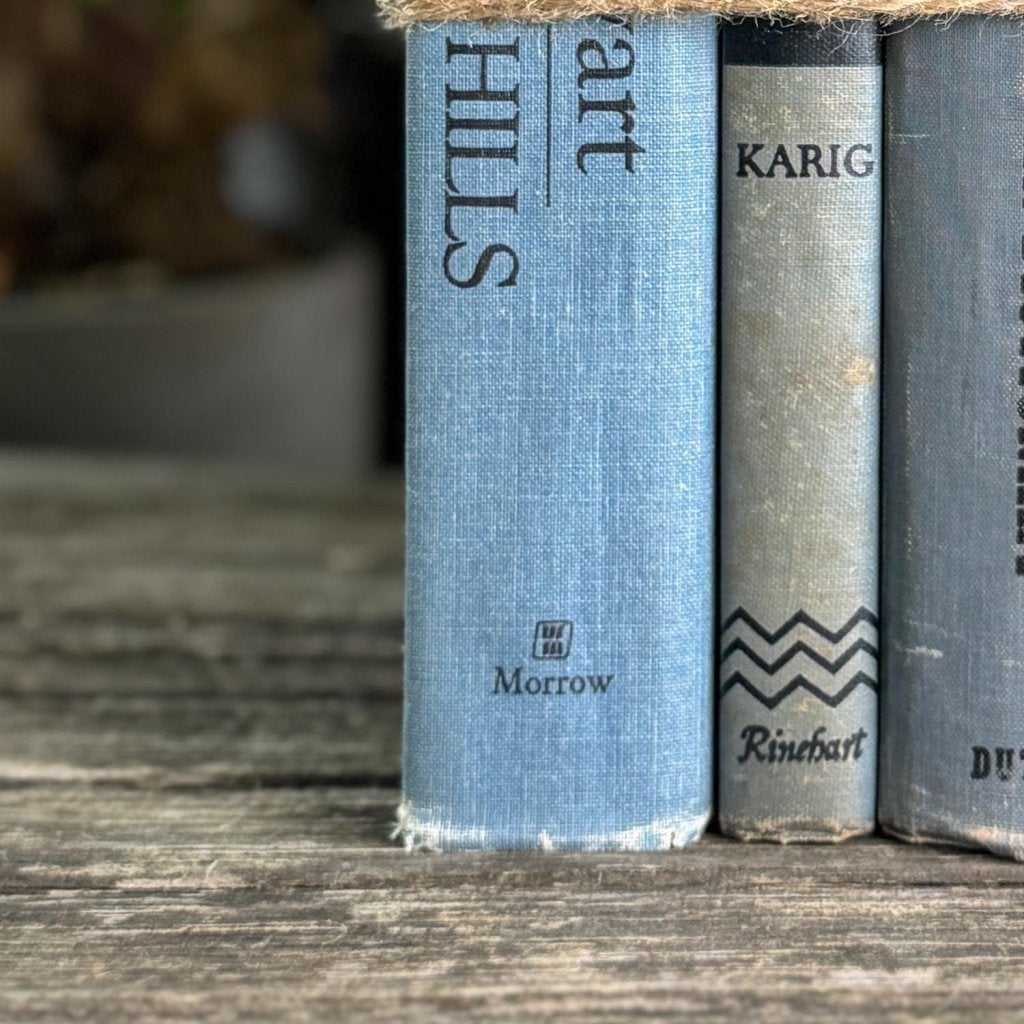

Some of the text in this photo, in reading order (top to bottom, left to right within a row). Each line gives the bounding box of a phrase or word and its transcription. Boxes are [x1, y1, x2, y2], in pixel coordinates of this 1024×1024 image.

[442, 35, 520, 289] HILLS
[736, 143, 876, 178] KARIG
[492, 666, 615, 695] Morrow
[738, 726, 867, 764] Rinehart
